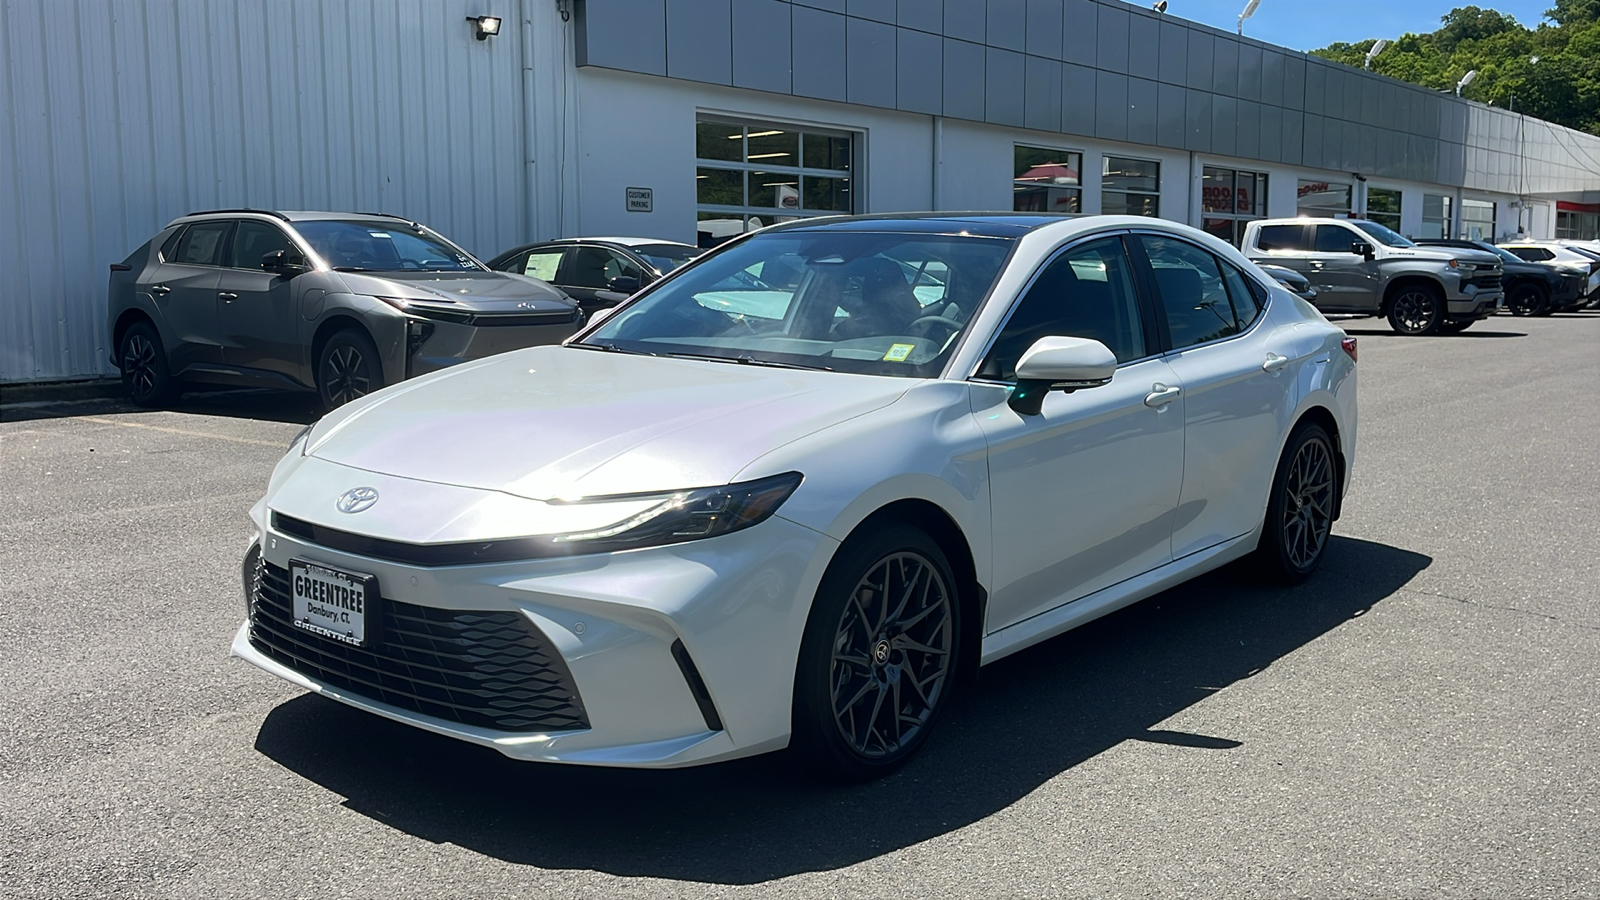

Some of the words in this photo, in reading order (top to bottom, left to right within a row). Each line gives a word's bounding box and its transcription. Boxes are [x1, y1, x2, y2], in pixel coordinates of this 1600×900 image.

[629, 191, 650, 199] CUSTOMER
[631, 200, 648, 208] PARKING
[295, 575, 363, 614] GREENTREE
[307, 602, 340, 623] Danbury,
[294, 619, 361, 647] GREENTREE
